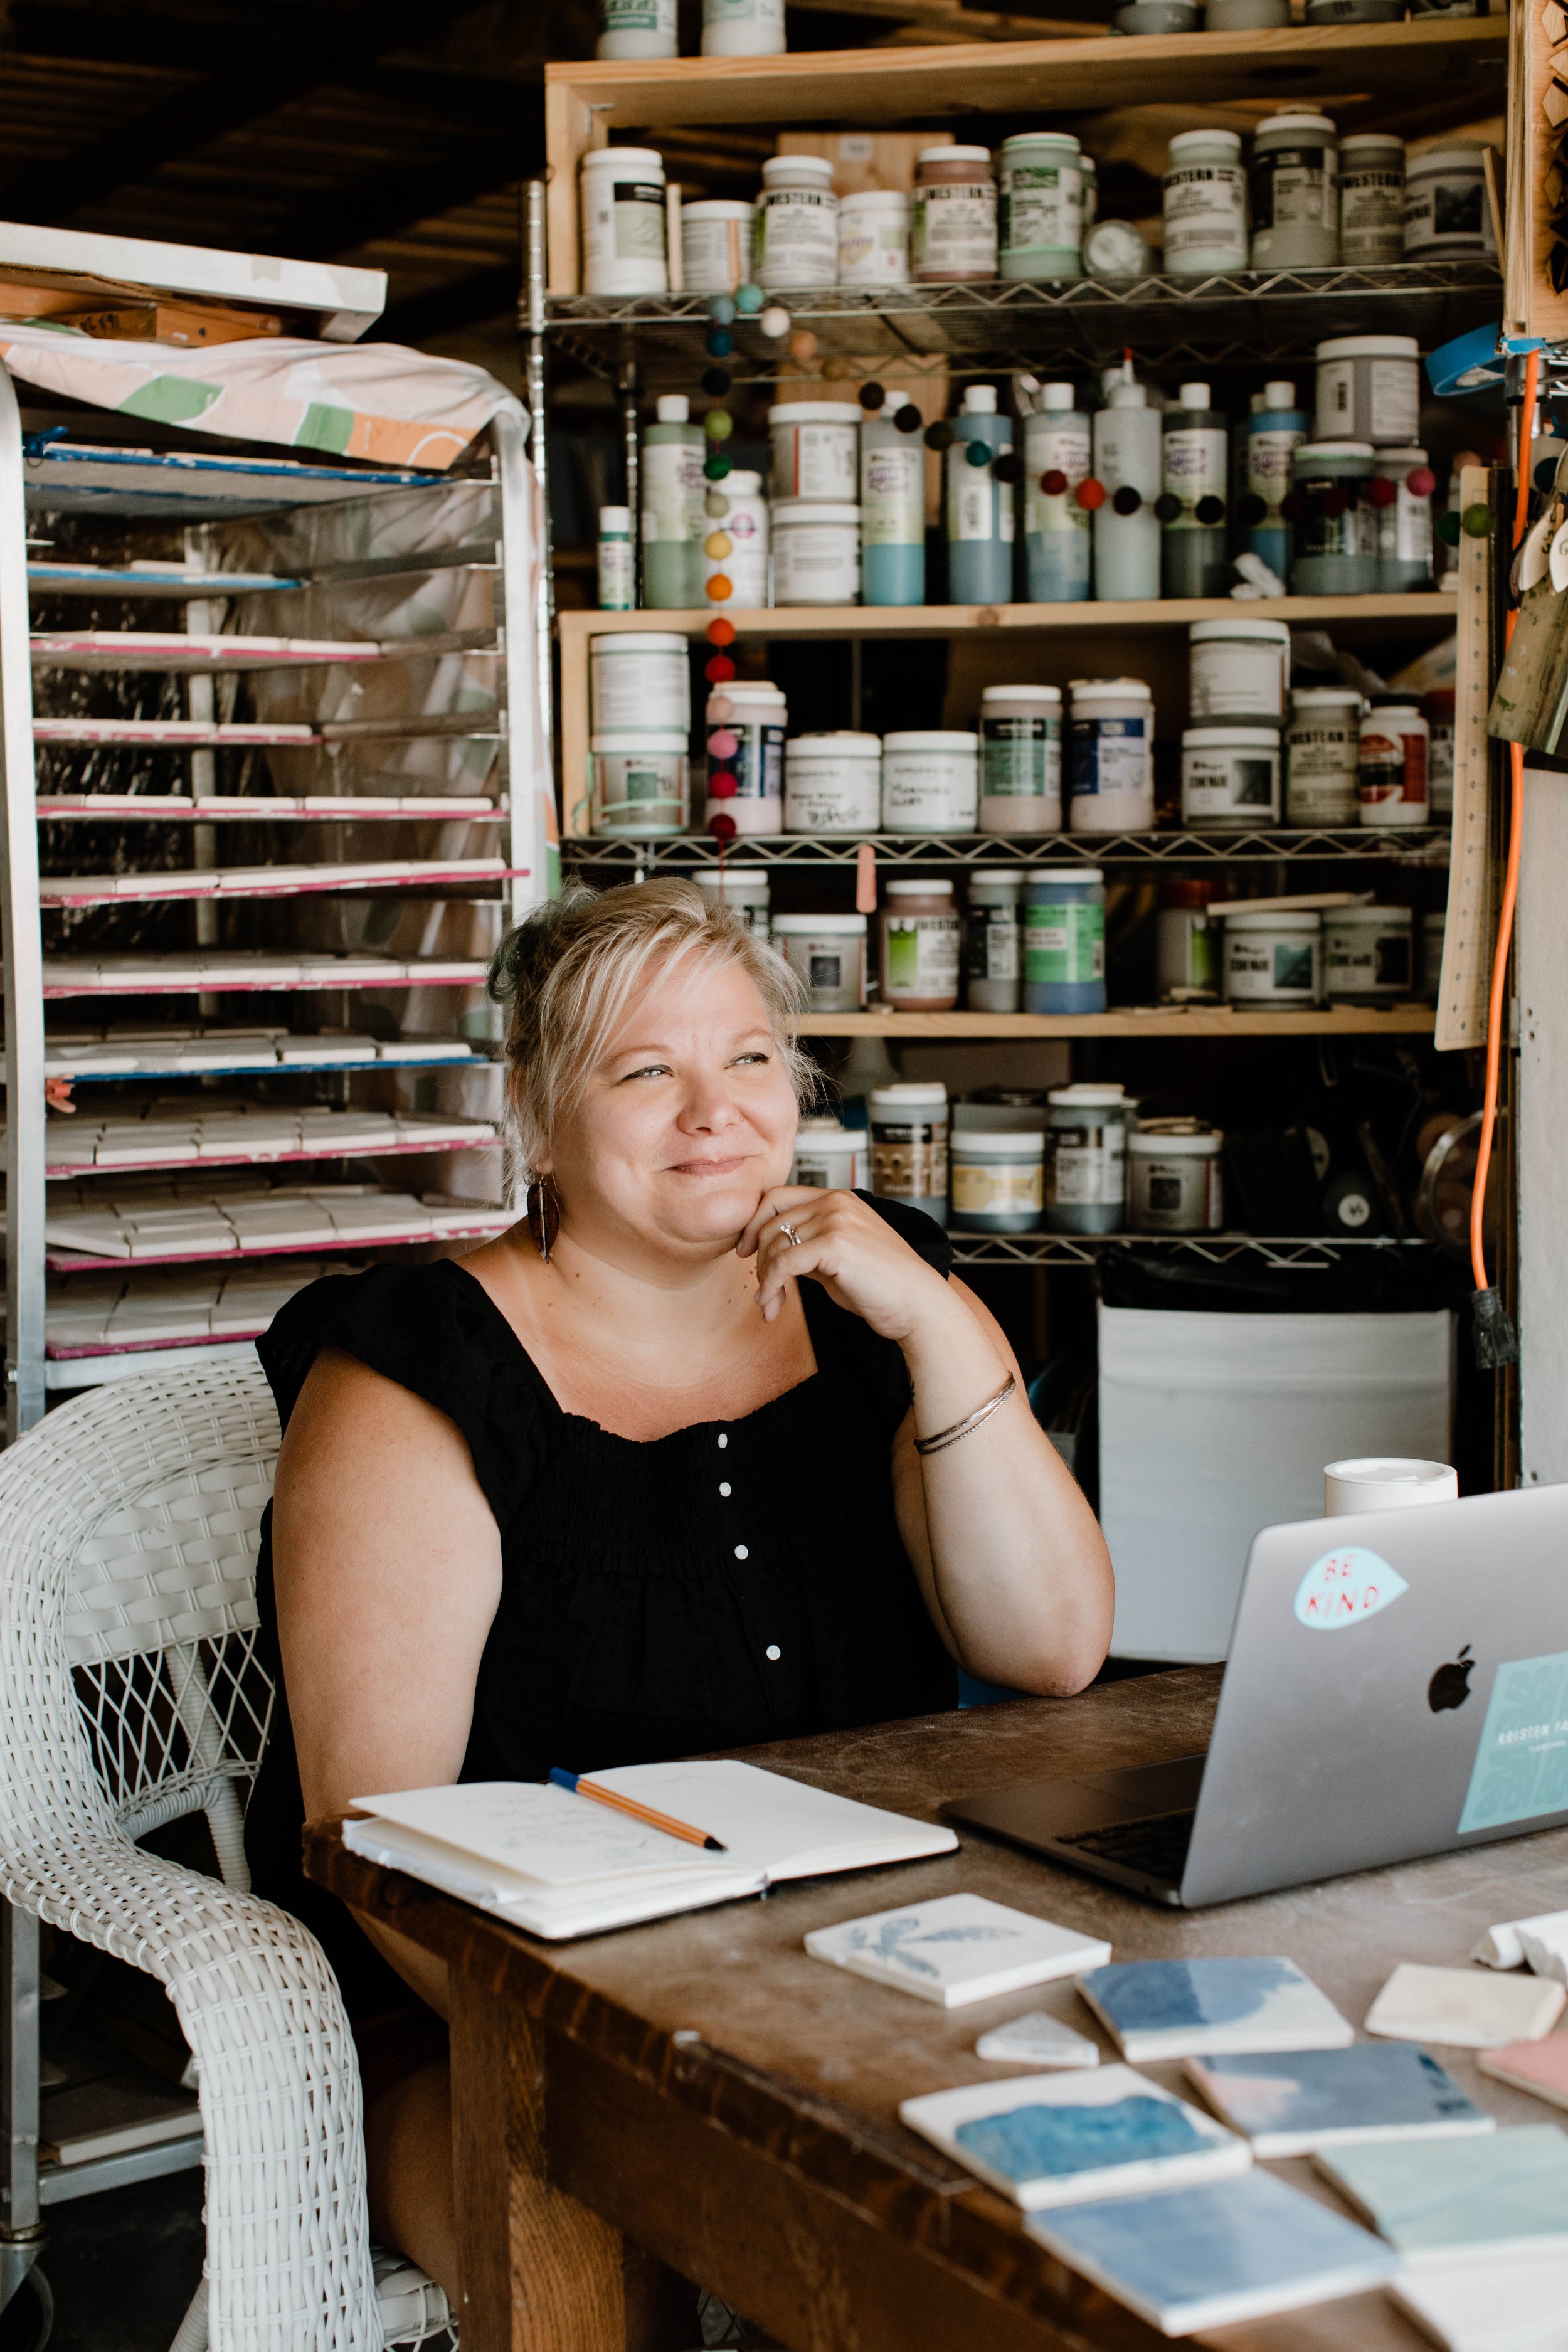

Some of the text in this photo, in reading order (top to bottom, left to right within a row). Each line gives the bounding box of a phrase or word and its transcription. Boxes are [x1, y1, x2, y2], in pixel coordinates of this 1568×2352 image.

[1324, 1554, 1355, 1581] BE
[1304, 1585, 1379, 1618] KIND
[1496, 1724, 1550, 1746] KRISTEN
